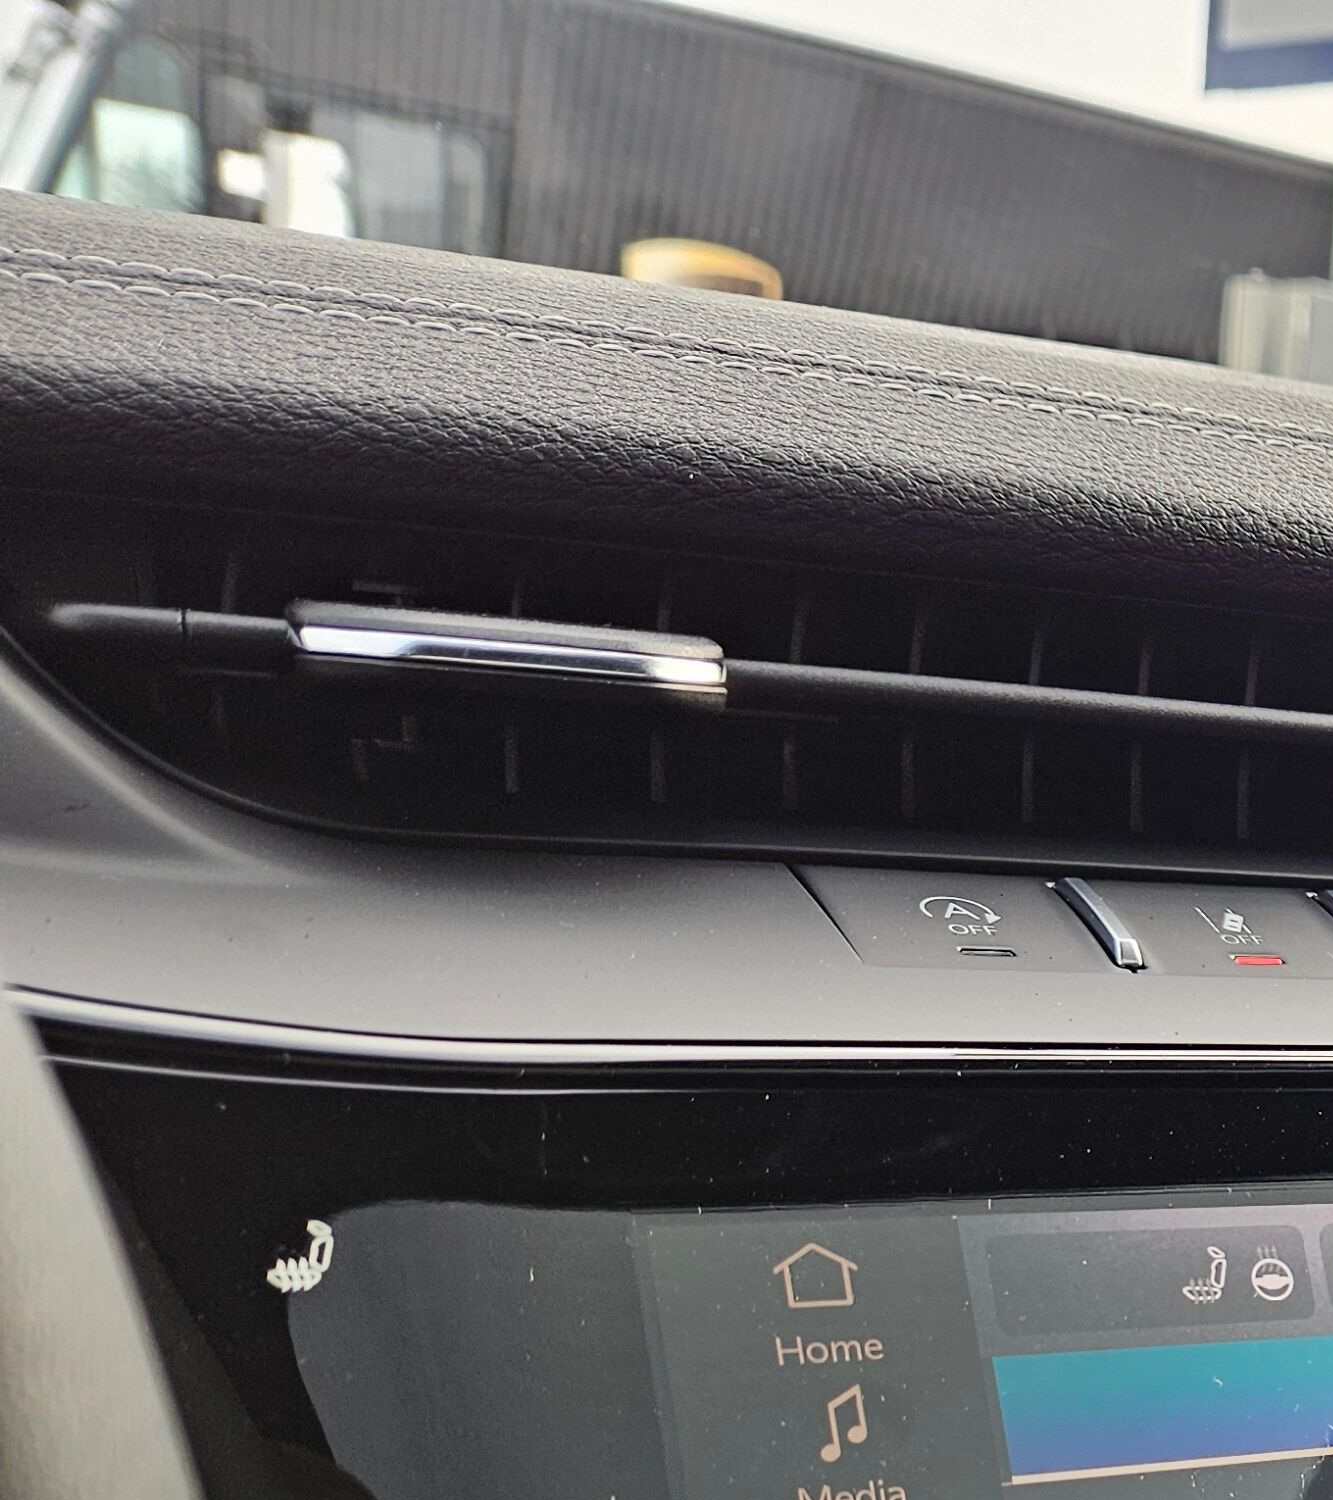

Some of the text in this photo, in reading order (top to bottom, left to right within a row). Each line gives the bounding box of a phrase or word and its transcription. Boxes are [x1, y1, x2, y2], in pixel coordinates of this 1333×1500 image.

[948, 923, 997, 936] OFF
[1222, 933, 1264, 946] OFF
[775, 1335, 885, 1366] Home
